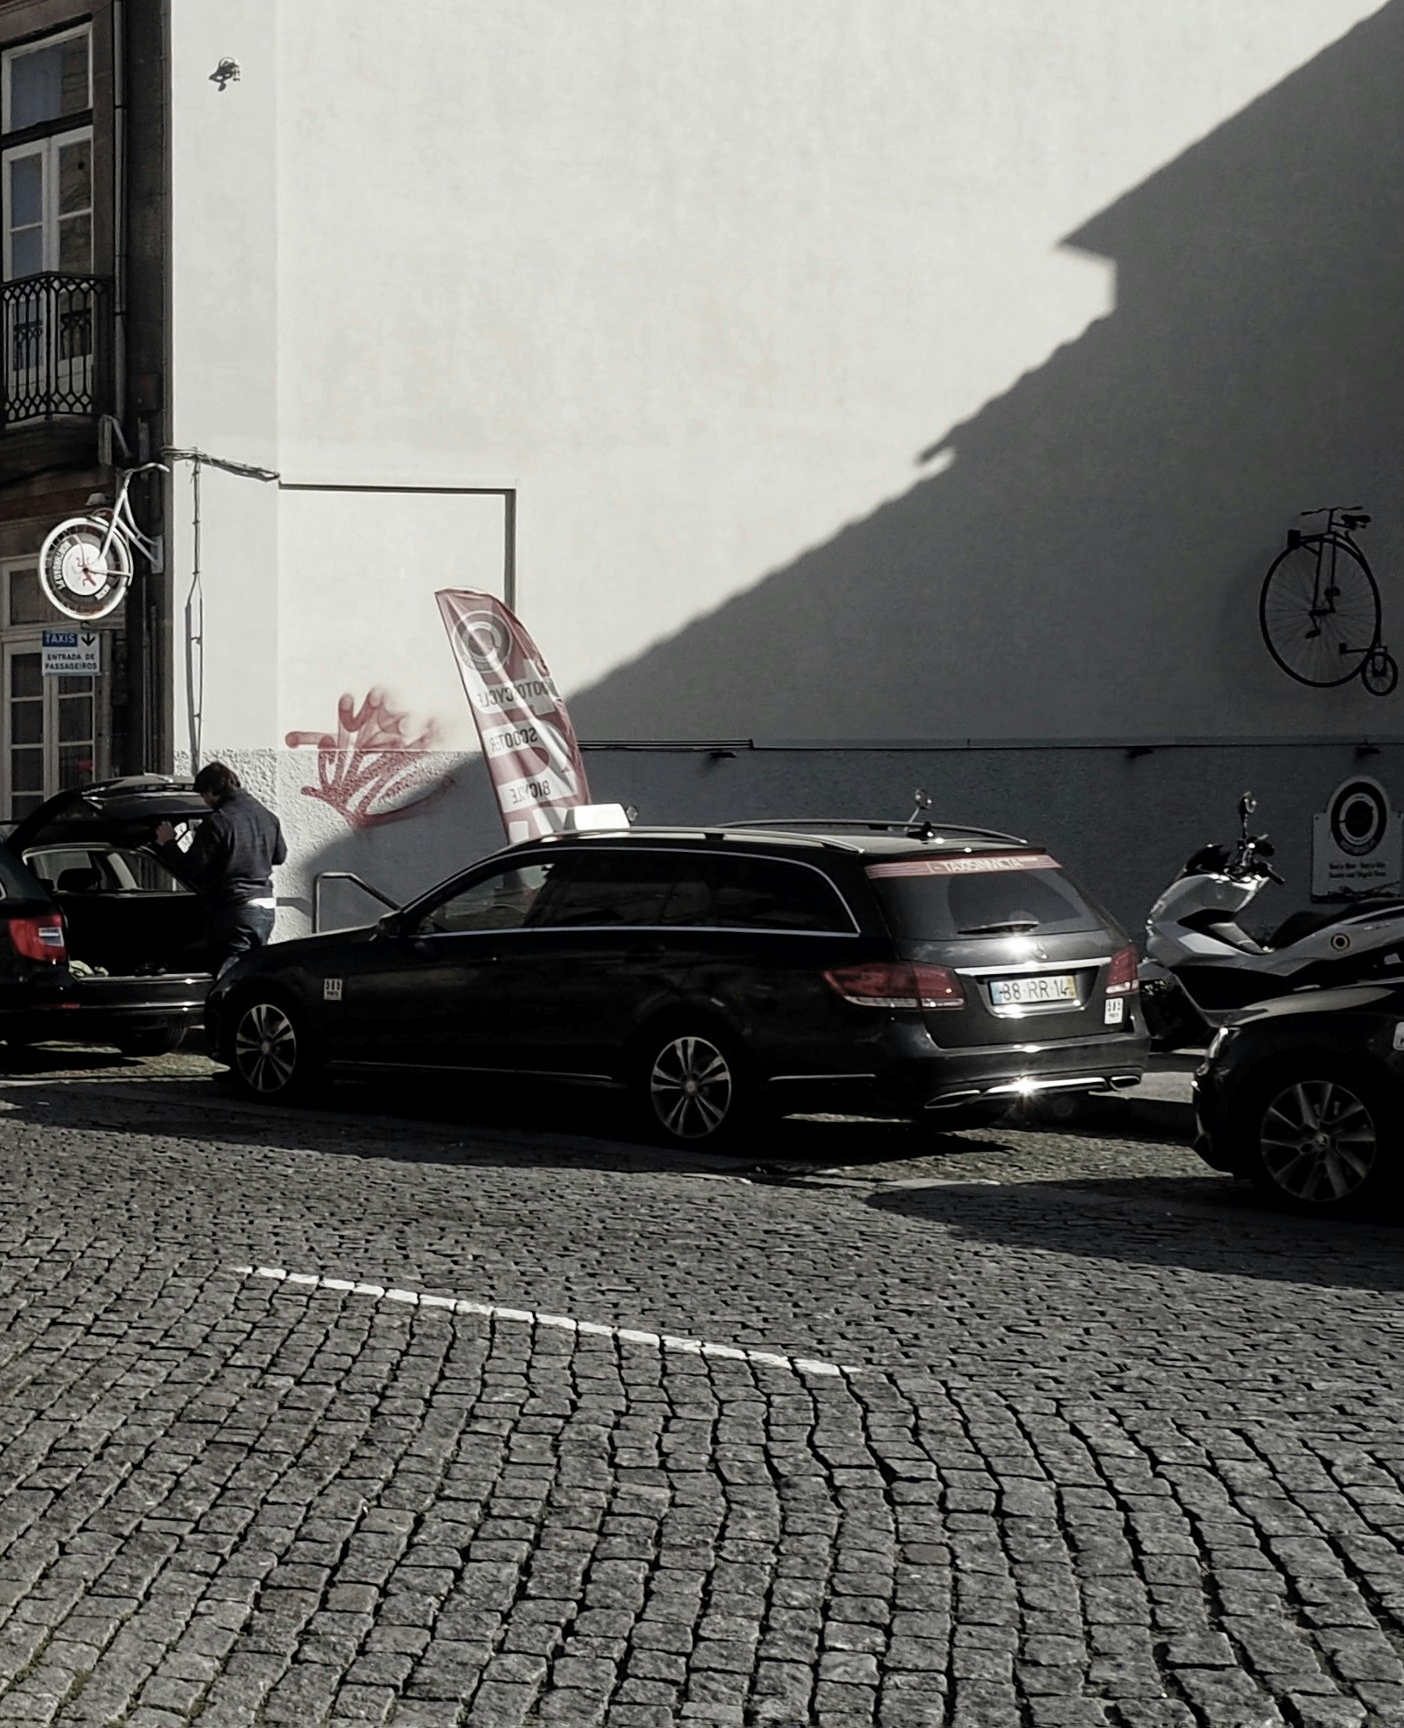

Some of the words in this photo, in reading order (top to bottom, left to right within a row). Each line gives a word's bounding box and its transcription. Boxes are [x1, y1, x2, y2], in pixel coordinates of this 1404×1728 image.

[45, 633, 75, 643] TAXIS
[47, 653, 81, 661] ENTRADA
[85, 653, 95, 661] DE
[45, 662, 97, 670] PASSAGEIROS
